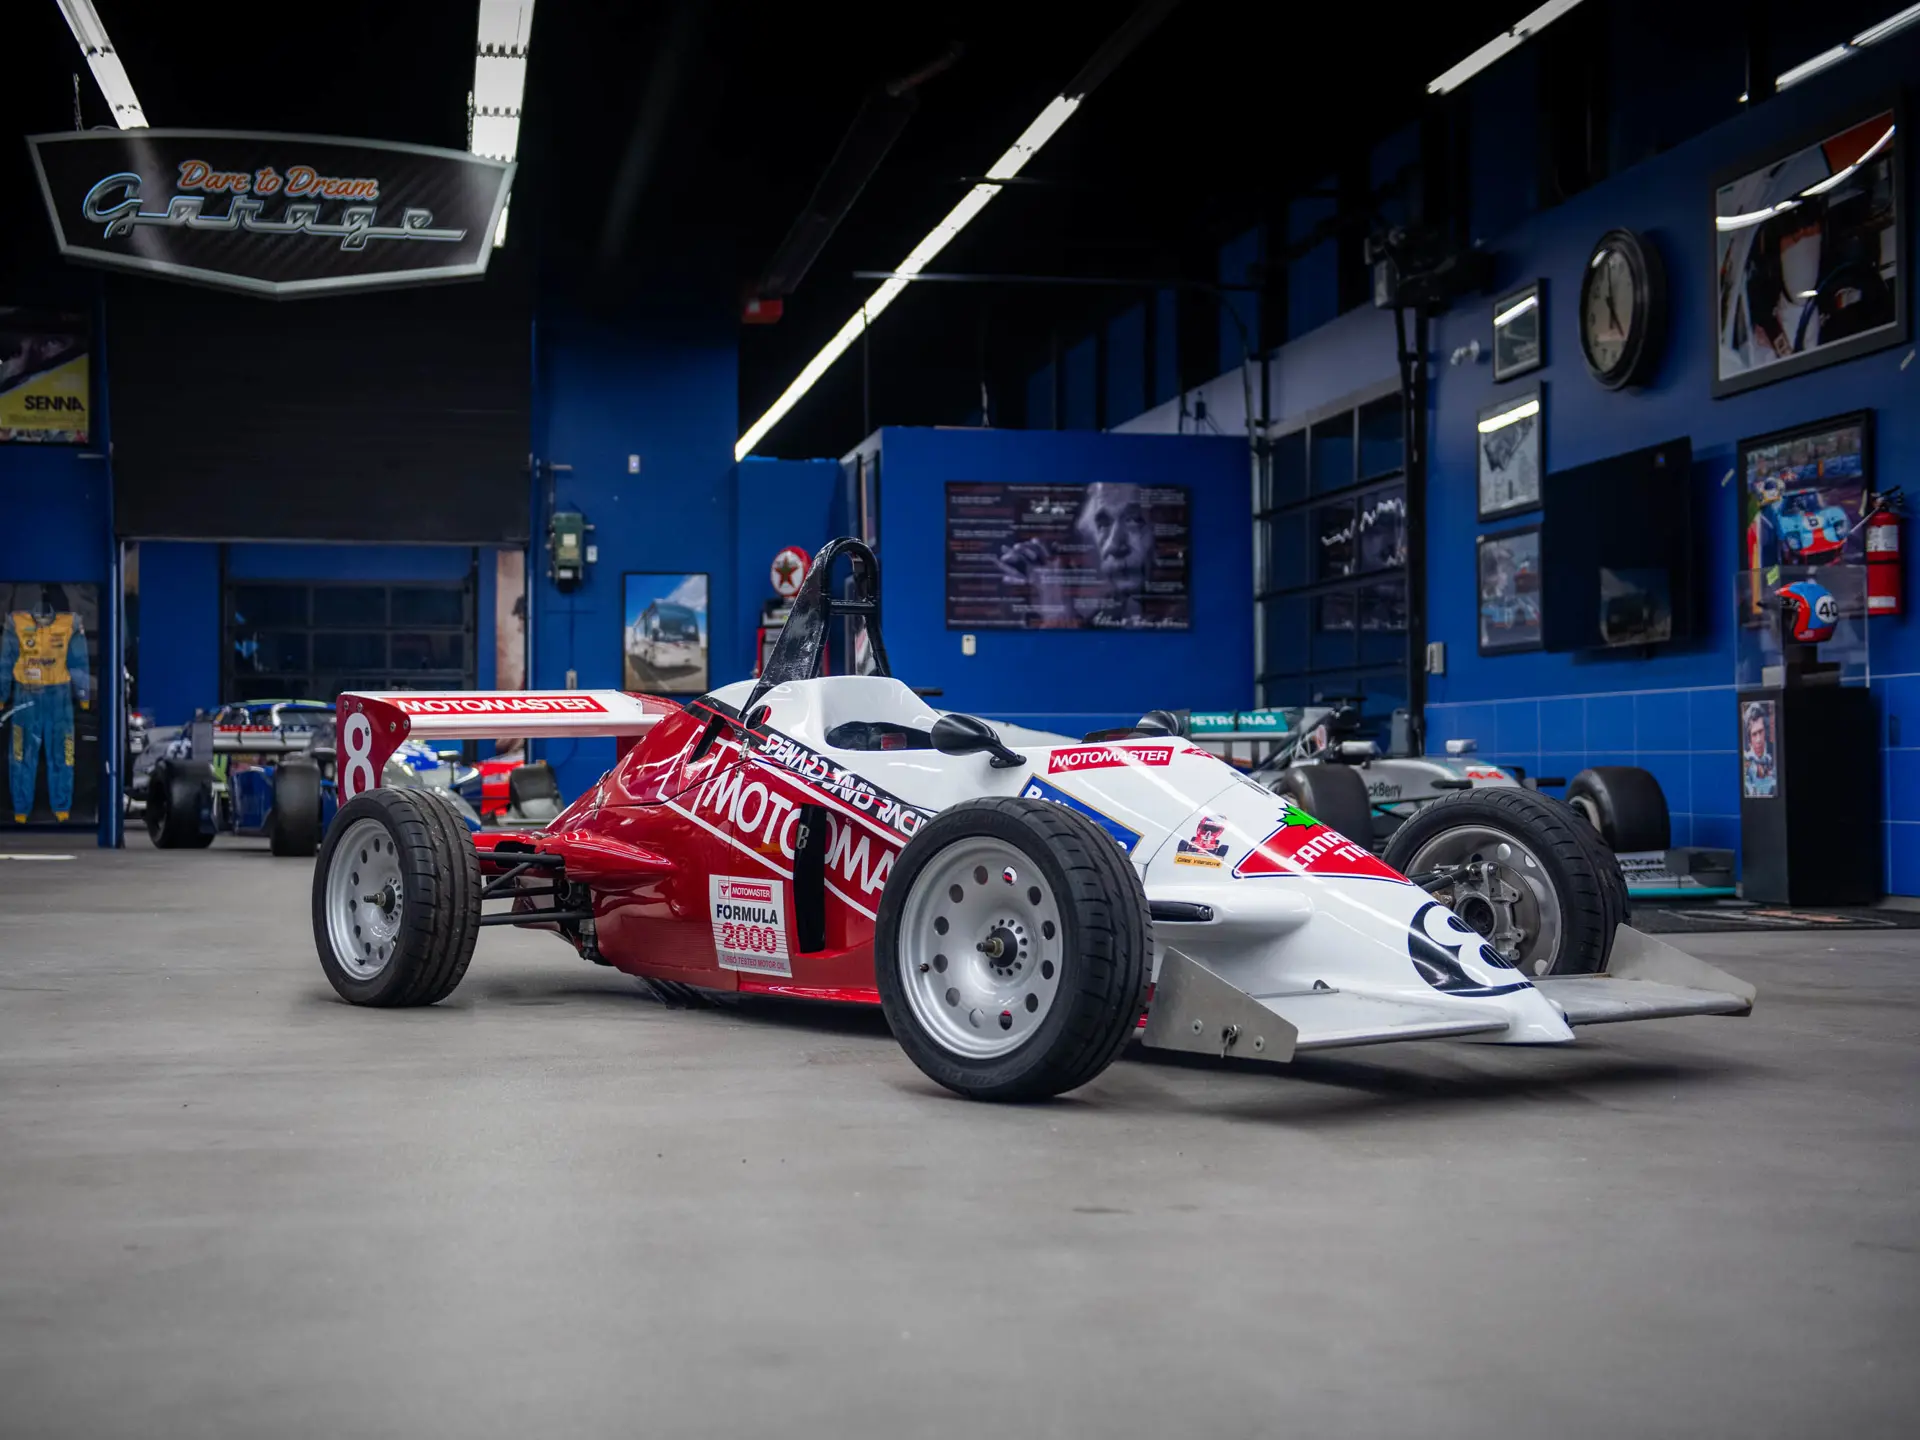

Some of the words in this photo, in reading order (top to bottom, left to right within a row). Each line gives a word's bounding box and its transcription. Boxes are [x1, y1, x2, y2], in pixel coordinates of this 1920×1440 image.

[177, 160, 250, 191] Dare
[256, 166, 283, 193] to
[287, 166, 379, 199] Dream
[83, 172, 467, 251] Garage
[25, 395, 85, 411] SENNA
[1819, 602, 1838, 618] 40
[397, 697, 598, 713] MOTOMASTER
[344, 712, 375, 801] 8
[1051, 750, 1169, 769] MOTOMASTER
[758, 733, 829, 781] SPENARD
[876, 797, 929, 837] RACI
[1467, 771, 1504, 780] 44
[1368, 782, 1402, 798] ckBerry
[702, 762, 897, 895] MOTOMA
[732, 886, 771, 898] MOTOMASTER
[716, 903, 778, 925] FORMULA
[722, 921, 777, 954] 2000
